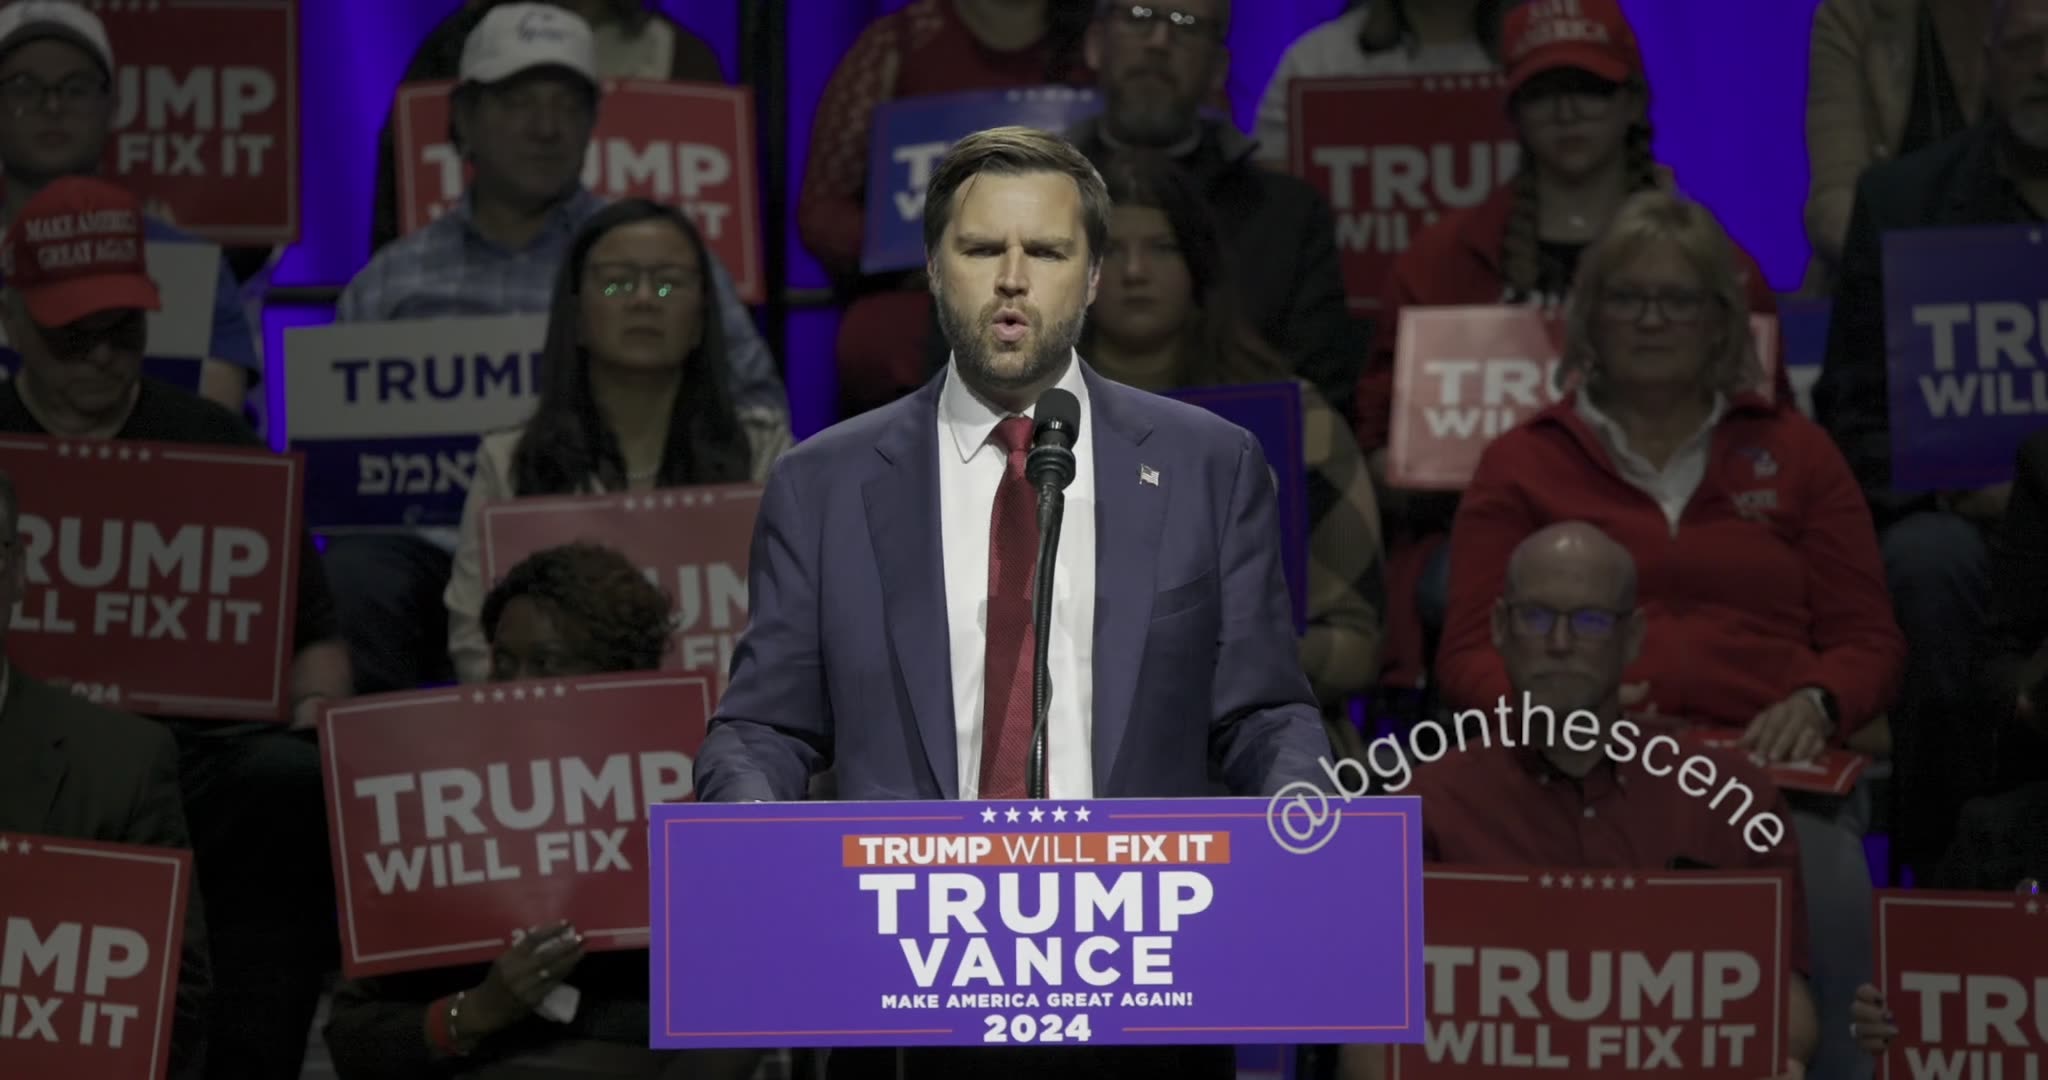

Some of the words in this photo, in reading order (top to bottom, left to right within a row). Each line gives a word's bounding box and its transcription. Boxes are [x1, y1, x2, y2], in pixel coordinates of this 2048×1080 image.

[112, 64, 278, 133] UMP
[117, 133, 206, 177] FIX
[220, 134, 275, 178] IT
[1314, 140, 1522, 209] TRU
[25, 215, 75, 243] MAKE
[1425, 407, 1515, 438] WI
[356, 450, 476, 497] אמפ
[15, 513, 270, 595] RUMP
[93, 591, 188, 640] FIX
[206, 600, 263, 645] IT
[354, 750, 695, 846] TRUMP
[363, 838, 521, 895] WILL
[535, 827, 632, 876] FIX
[858, 836, 992, 865] TRUMP
[1002, 835, 1096, 864] WILL
[1106, 834, 1173, 863] FIX
[1178, 833, 1214, 863] IT
[858, 870, 1214, 935] TRUMP
[899, 935, 1174, 988] VANCE
[1424, 945, 1761, 1021] TRUMP
[0, 993, 64, 1043] IX
[79, 1000, 140, 1049] IT
[881, 994, 940, 1009] MAKE
[946, 993, 1041, 1008] AMERICA
[1046, 992, 1114, 1008] GREAT
[1120, 991, 1194, 1007] AGAIN!
[983, 1013, 1092, 1043] 2024
[1424, 1020, 1570, 1069] WILL
[1586, 1024, 1685, 1071] FIX
[1702, 1023, 1757, 1068] IT
